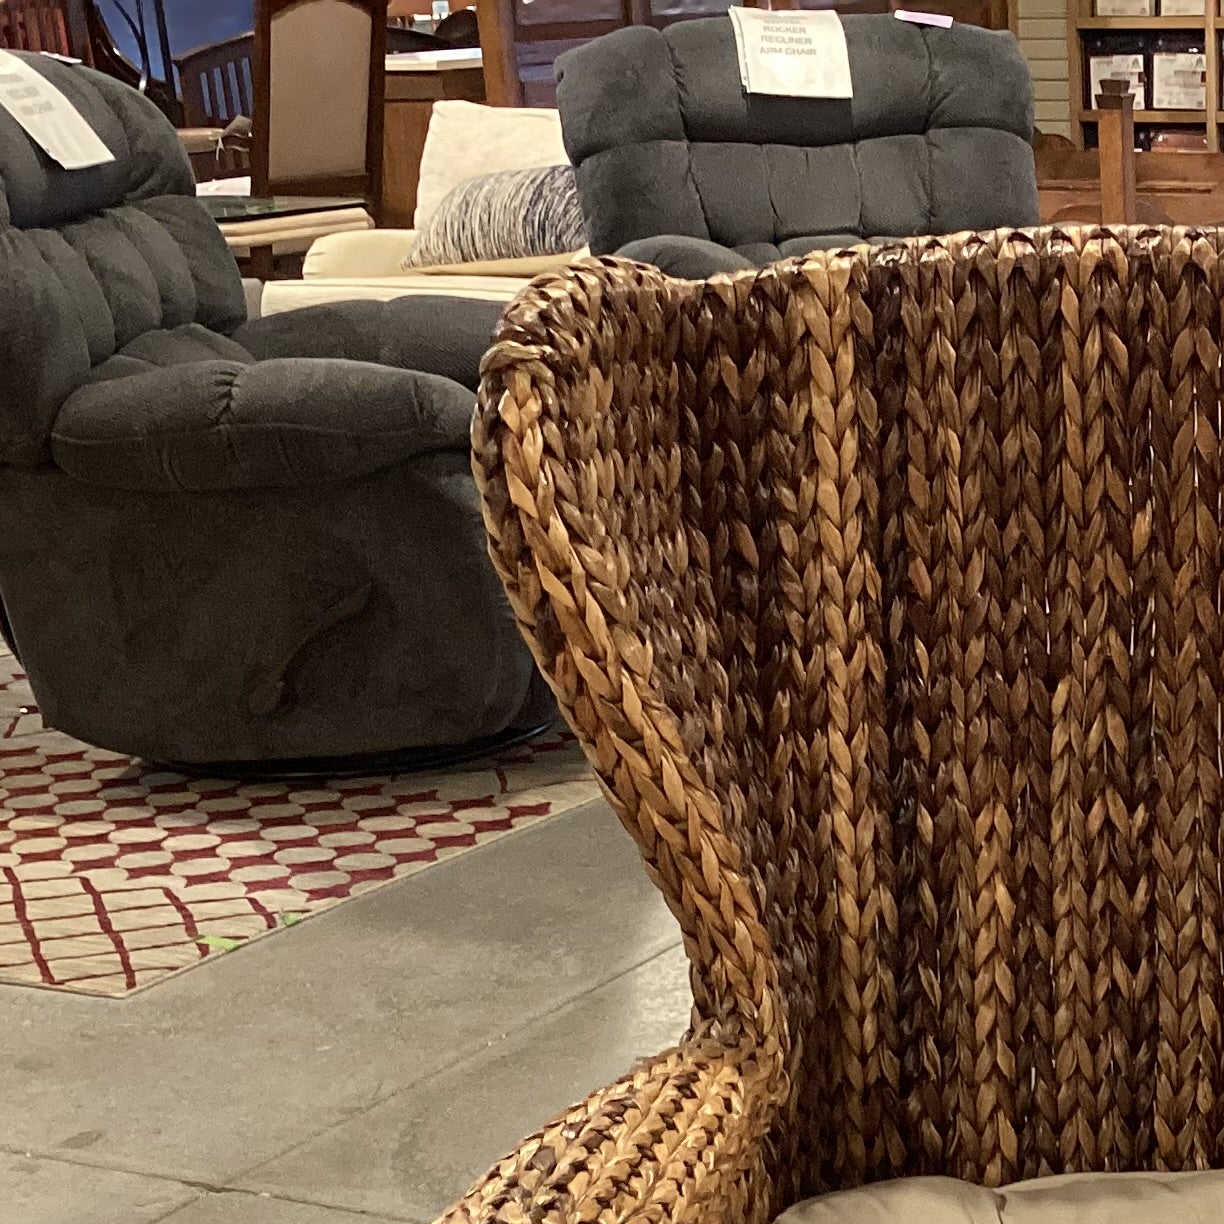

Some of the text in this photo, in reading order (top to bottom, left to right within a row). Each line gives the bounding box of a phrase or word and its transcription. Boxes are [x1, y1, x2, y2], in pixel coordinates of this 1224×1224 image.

[763, 26, 806, 34] ROCKER
[761, 35, 812, 45] RECLINER
[785, 47, 817, 56] CHAIR
